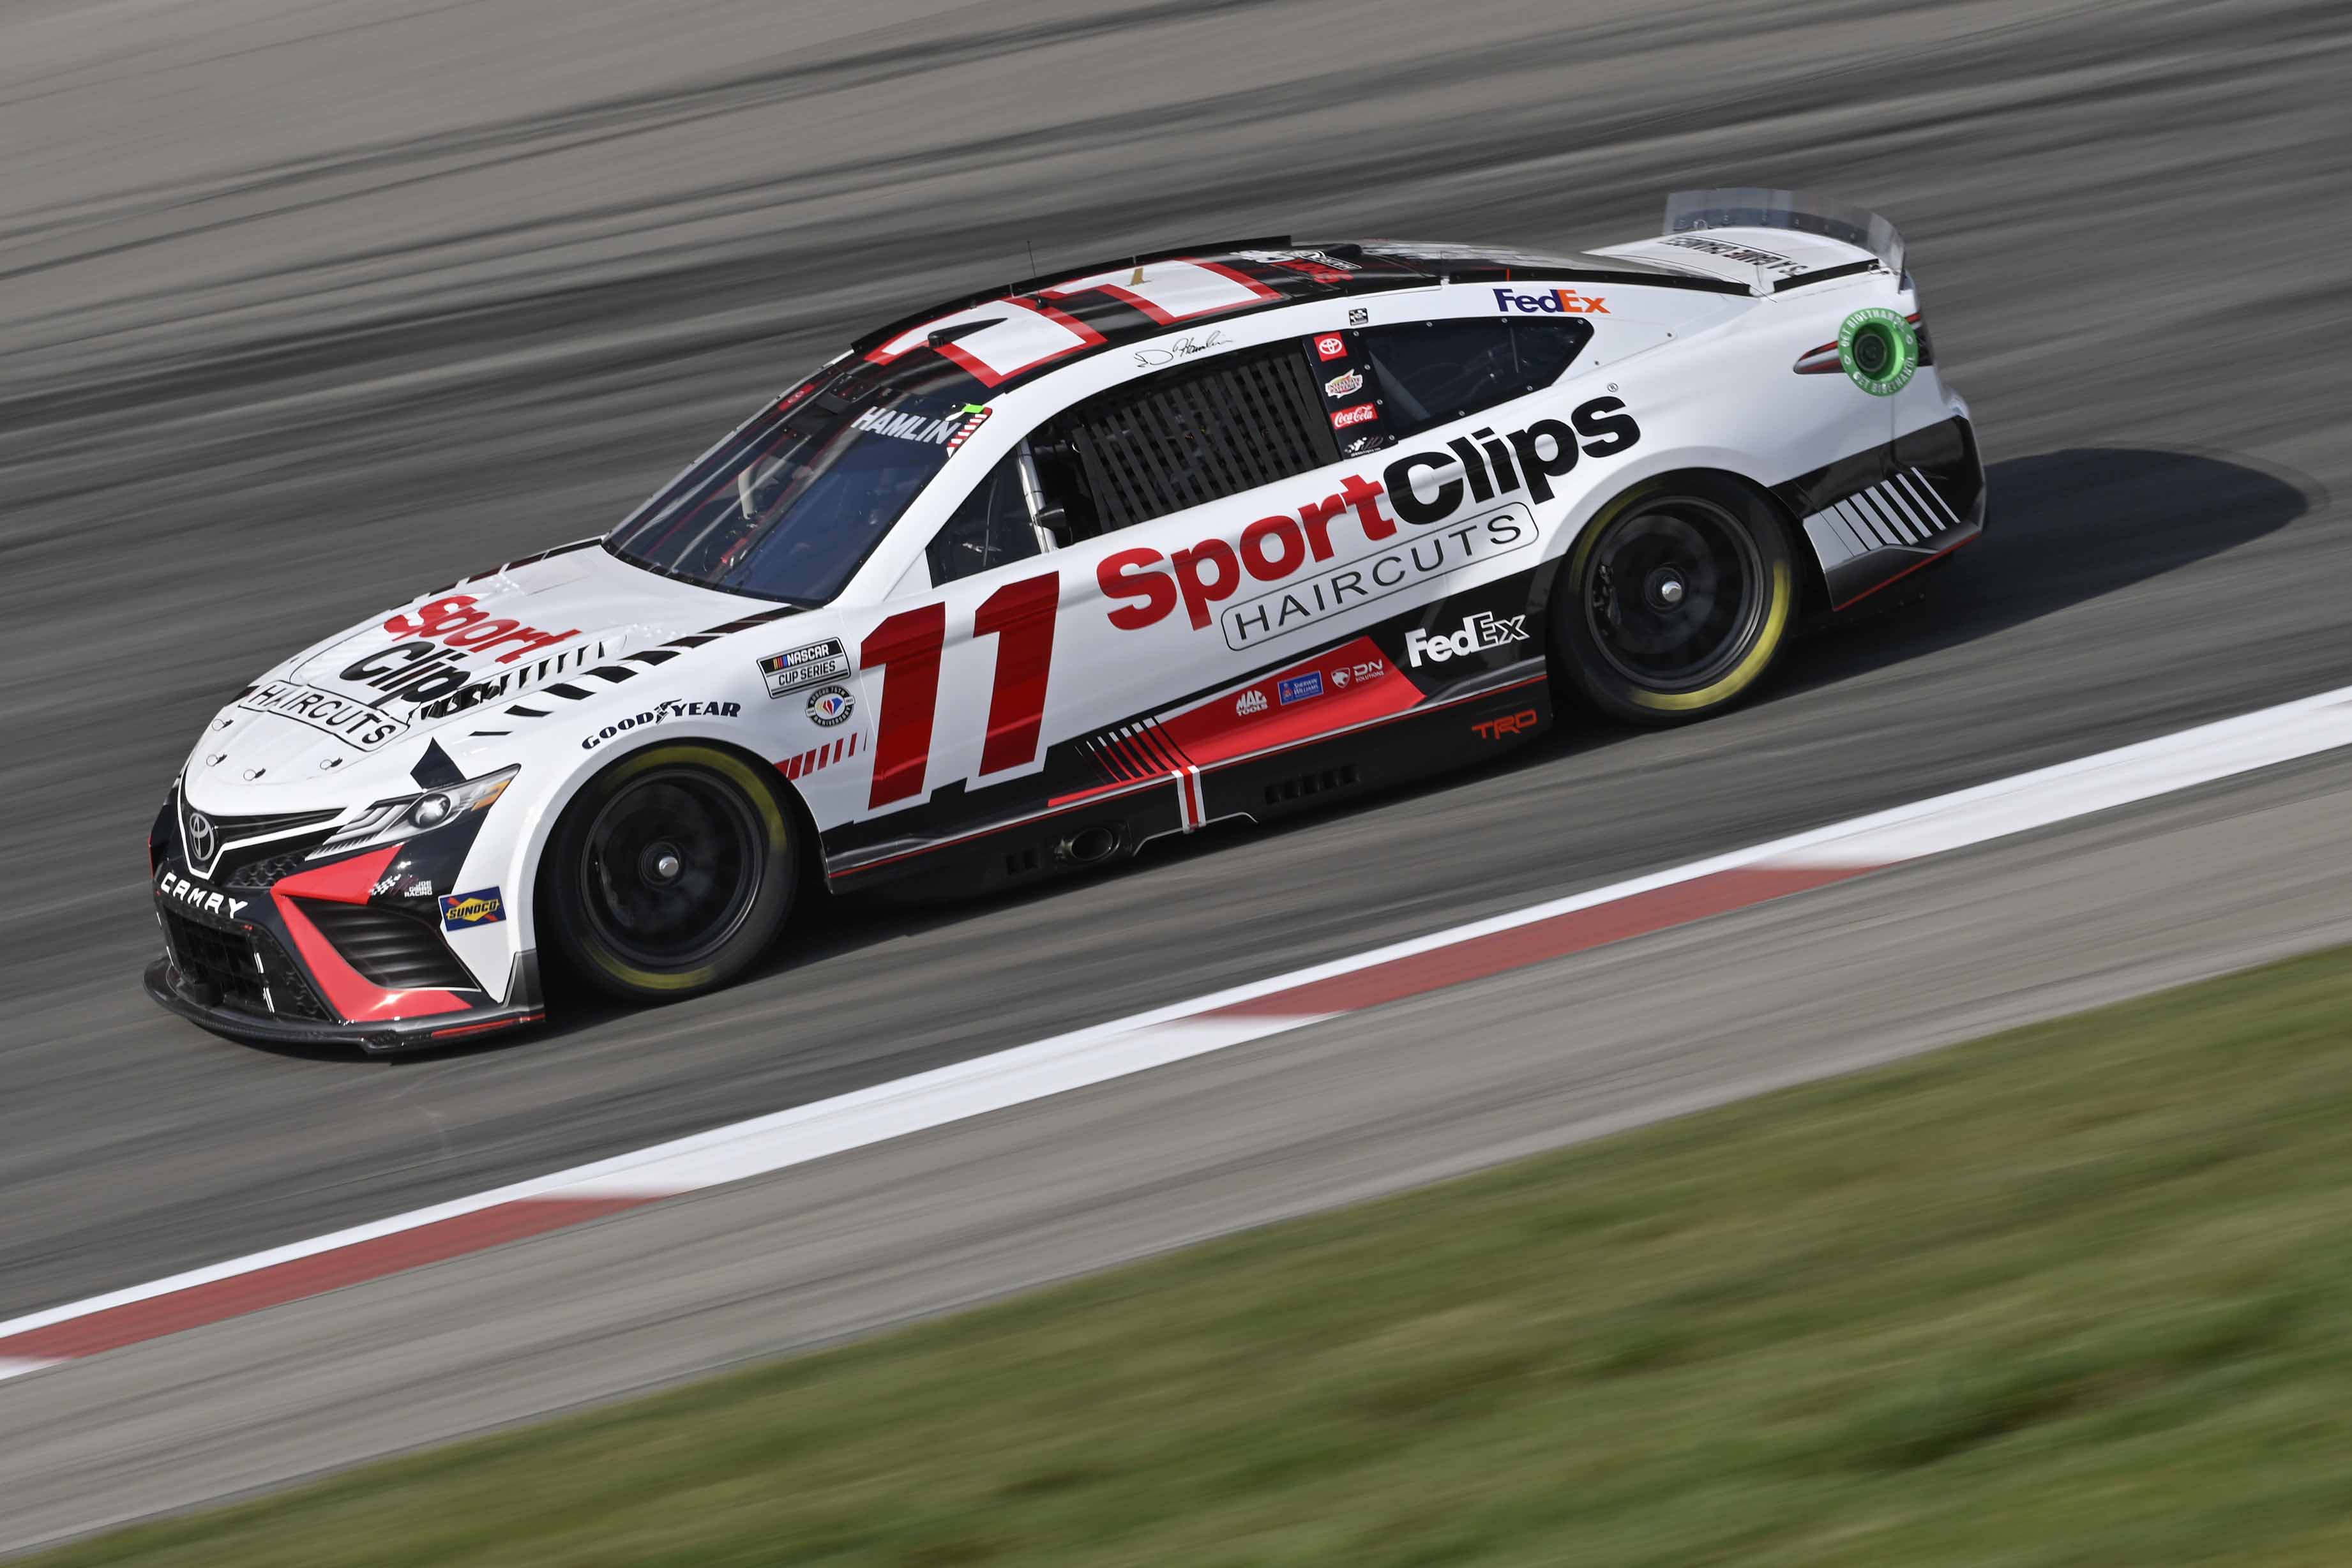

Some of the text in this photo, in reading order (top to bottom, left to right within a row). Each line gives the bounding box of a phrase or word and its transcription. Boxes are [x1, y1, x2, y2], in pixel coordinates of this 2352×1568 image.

[1492, 289, 1611, 314] FedEx
[851, 405, 961, 444] HAMLIN
[1234, 513, 1522, 641] HAIRCUTS
[383, 595, 582, 664] Sport
[1405, 611, 1530, 668] FedEx
[787, 644, 829, 666] NASCAR
[1353, 659, 1383, 677] DN
[778, 660, 836, 686] CUP SERIES
[859, 570, 1060, 811] 11
[1237, 690, 1267, 711] MAC
[248, 684, 396, 744] HAIRCUTS
[582, 700, 741, 750] GOODYEAR
[1237, 704, 1268, 716] TOOLS
[1471, 709, 1537, 739] TRD
[161, 872, 248, 919] CAMRY
[448, 900, 498, 919] SUNOCO
